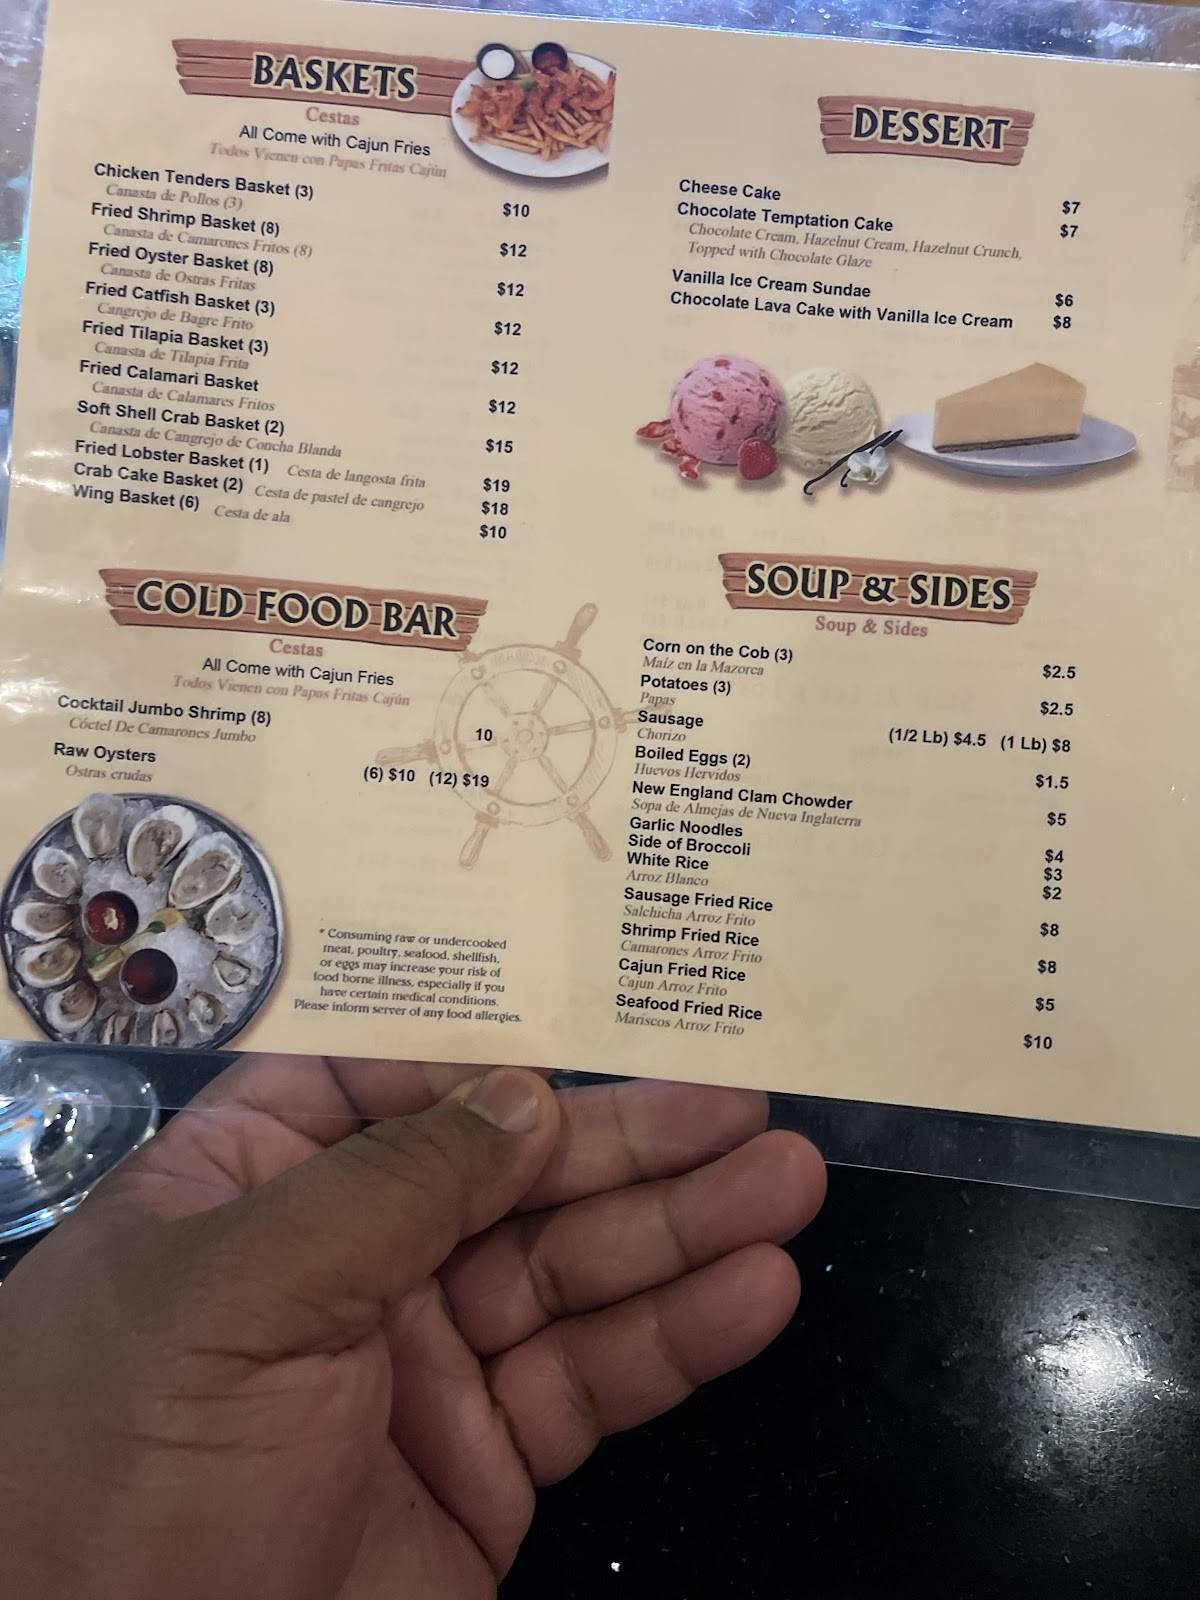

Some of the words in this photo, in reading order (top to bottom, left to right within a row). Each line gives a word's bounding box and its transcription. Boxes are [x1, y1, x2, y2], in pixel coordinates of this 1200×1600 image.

[252, 53, 417, 100] BASKETS
[305, 107, 360, 126] Cestas
[853, 107, 1010, 149] DESSERT
[239, 125, 258, 139] All
[263, 127, 307, 144] Come
[311, 133, 341, 147] with
[346, 135, 389, 153] Cajun
[394, 139, 431, 156] Fries
[94, 162, 159, 182] Chicken
[165, 169, 230, 189] Tenders
[235, 177, 290, 196] Basket
[295, 184, 313, 201] (3)
[679, 179, 738, 196] Cheese
[742, 184, 781, 201] Cake
[503, 202, 530, 218] $10
[677, 201, 756, 221] Chocolate
[761, 209, 849, 229] Temptation
[854, 216, 893, 232] Cake
[1062, 200, 1080, 215] $7
[92, 202, 133, 219] Fried
[137, 207, 196, 229] Shrimp
[201, 213, 256, 233] Basket
[261, 221, 279, 237] (8)
[689, 222, 752, 239] Chocolate
[803, 232, 860, 249] Hazelnut
[912, 240, 969, 255] Hazelnut
[1060, 224, 1078, 238] $7
[500, 242, 527, 257] $12
[497, 282, 524, 297] $12
[672, 269, 725, 285] Vanilla
[730, 273, 752, 287] Ice
[757, 276, 807, 293] Cream
[812, 281, 871, 298] Sundae
[671, 291, 749, 309] Chocolate
[755, 297, 791, 314] Lava
[796, 301, 834, 317] Cake
[839, 305, 871, 320] with
[877, 307, 929, 324] Vanilla
[934, 311, 957, 325] Ice
[962, 313, 1013, 328] Cream
[1055, 293, 1073, 308] $6
[494, 321, 521, 336] $12
[1053, 315, 1071, 330] $8
[80, 359, 122, 377] Fried
[127, 365, 199, 385] Calamari
[204, 373, 259, 392] Basket
[491, 360, 518, 375] $12
[489, 399, 516, 414] $12
[77, 400, 111, 416] Soft
[116, 404, 156, 421] Shell
[161, 409, 200, 425] Crab
[205, 413, 260, 432] Basket
[265, 419, 284, 437] (2)
[486, 438, 513, 454] $15
[75, 439, 117, 456] Fried
[122, 444, 185, 463] Lobster
[189, 451, 244, 469] Basket
[249, 457, 269, 475] (1)
[483, 477, 510, 493] $19
[72, 484, 114, 504] Wing
[120, 488, 175, 507] Basket
[179, 494, 199, 512] (6)
[481, 500, 508, 516] $18
[480, 524, 507, 539] $10
[746, 564, 848, 602] SOUP
[863, 575, 895, 604] &
[910, 577, 1013, 610] SIDES
[135, 580, 244, 618] COLD
[256, 591, 369, 629] FOOD
[381, 604, 457, 638] BAR
[815, 616, 857, 637] Soup
[863, 619, 878, 634] &
[883, 620, 928, 638] Sides
[270, 638, 324, 658] Cestas
[643, 638, 680, 653] Corn
[686, 644, 704, 655] on
[709, 643, 734, 657] the
[739, 645, 770, 659] Cob
[774, 648, 793, 664] (3)
[643, 655, 675, 669] Maíz
[677, 661, 692, 671] en
[696, 659, 707, 672] la
[710, 660, 764, 676] Mazorca
[1043, 664, 1076, 679] $2.5
[641, 674, 708, 692] Potatoes
[713, 680, 731, 696] (3)
[58, 694, 124, 713] Cocktail
[128, 701, 184, 717] Jumbo
[188, 705, 246, 725] Shrimp
[251, 710, 271, 727] (8)
[1040, 701, 1073, 716] $2.5
[638, 710, 703, 729] Sausage
[476, 728, 493, 742] 10
[637, 727, 686, 741] Chorizo
[889, 728, 917, 744] (1/2
[923, 730, 948, 747] Lb)
[954, 731, 986, 747] $4.5
[1001, 735, 1014, 752] (1
[1021, 736, 1047, 754] Lb)
[1052, 738, 1071, 753] $8
[54, 742, 89, 757] Raw
[94, 745, 156, 763] Oysters
[635, 745, 684, 761] Boiled
[689, 749, 728, 767] Eggs
[733, 753, 750, 769] (2)
[364, 766, 383, 783] (6)
[388, 768, 415, 782] $10
[429, 771, 457, 789] (12)
[463, 773, 489, 788] $19
[1036, 774, 1069, 789] $1.5
[632, 780, 665, 795] New
[670, 783, 733, 801] England
[738, 789, 777, 804] Clam
[782, 792, 853, 810] Chowder
[630, 816, 675, 832] Garlic
[680, 820, 743, 837] Noodles
[1047, 811, 1067, 826] $5
[628, 833, 662, 849] Side
[666, 837, 683, 850] of
[686, 838, 751, 856] Broccoli
[627, 851, 670, 867] White
[675, 855, 709, 870] Rice
[1045, 849, 1064, 864] $4
[626, 869, 663, 883] Arroz
[665, 872, 709, 886] Blanco
[1044, 867, 1063, 882] $3
[624, 887, 690, 907] Sausage
[695, 892, 734, 908] Fried
[739, 896, 773, 912] Rice
[1042, 885, 1062, 900] $2
[621, 922, 676, 942] Shrimp
[681, 927, 720, 943] Fried
[725, 931, 759, 947] Rice
[1040, 922, 1059, 937] $8
[619, 958, 663, 975] Cajun
[668, 962, 707, 978] Fried
[712, 966, 746, 982] Rice
[1038, 959, 1056, 974] $8
[616, 993, 679, 1012] Seafood
[684, 1000, 723, 1016] Fried
[728, 1004, 762, 1020] Rice
[1035, 997, 1055, 1012] $5
[1023, 1034, 1052, 1050] $10
